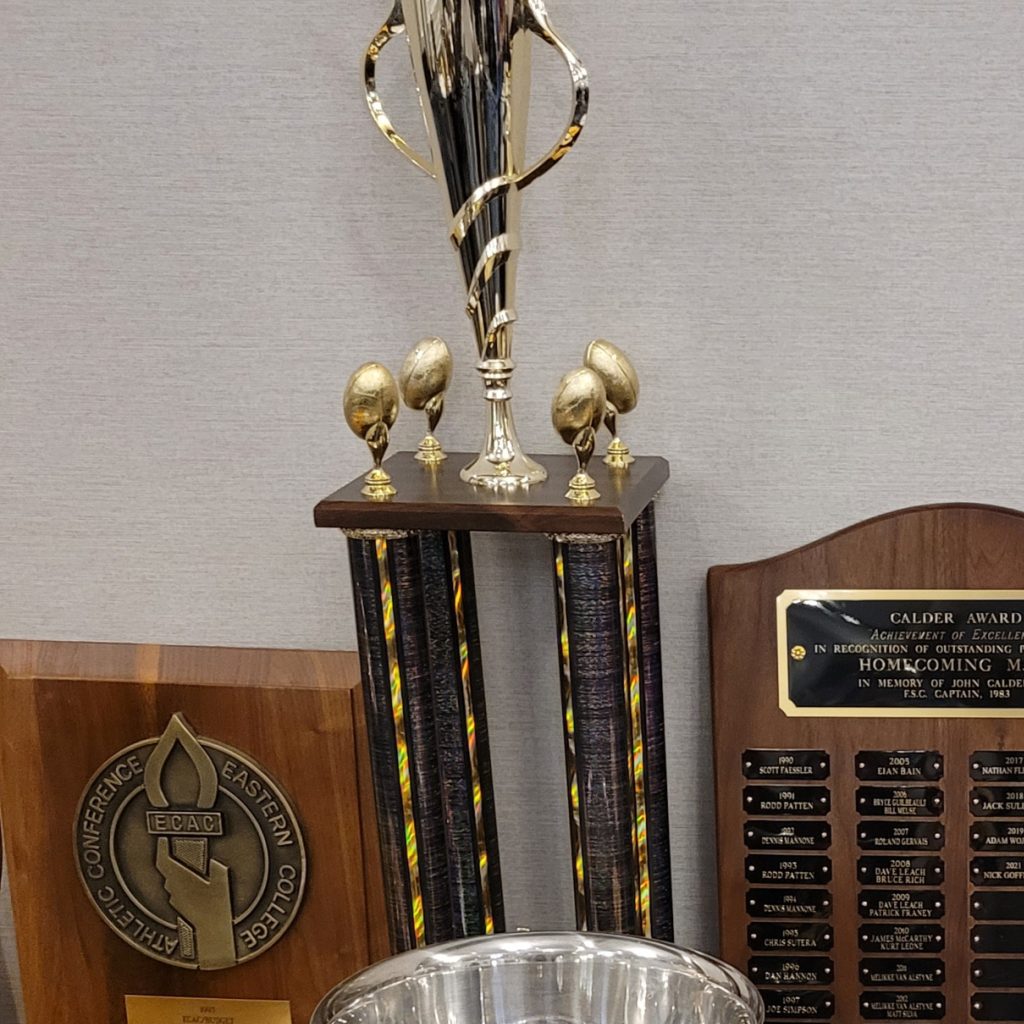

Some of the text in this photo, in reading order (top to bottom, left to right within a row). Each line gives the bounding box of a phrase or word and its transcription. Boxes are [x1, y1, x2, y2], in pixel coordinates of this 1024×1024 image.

[890, 612, 1022, 624] CALDER AWARD
[952, 631, 965, 640] OF
[815, 644, 826, 654] IN
[834, 644, 908, 654] RECOGNITION
[915, 644, 928, 654] OF
[936, 644, 1011, 654] OUTSTANDING
[859, 658, 992, 672] HOMECOMING
[858, 679, 870, 688] IN
[878, 679, 923, 688] MEMORY
[931, 679, 944, 688] OF
[952, 679, 979, 688] JOHN
[904, 689, 1010, 700] F.S.C. CAPTAIN, 1983
[1006, 757, 1023, 765] 2017
[982, 767, 1012, 775] NATHAN
[1006, 792, 1023, 800] 2018
[761, 802, 813, 810] RODD PATTEN
[983, 802, 1004, 810] JACK
[155, 815, 215, 832] ECAC
[986, 837, 1008, 845] ADAM
[82, 755, 296, 955] EASTERN COLLEGE ATHLETIC CONFERENCE
[890, 860, 910, 868] 2008
[1006, 862, 1021, 870] 2021
[762, 871, 814, 879] RODD PATTEN
[875, 868, 925, 876] DAVE LEACH
[876, 876, 925, 884] BRUCE RICH
[869, 909, 932, 917] PATRICK FRANEY
[871, 935, 895, 943] JAMES
